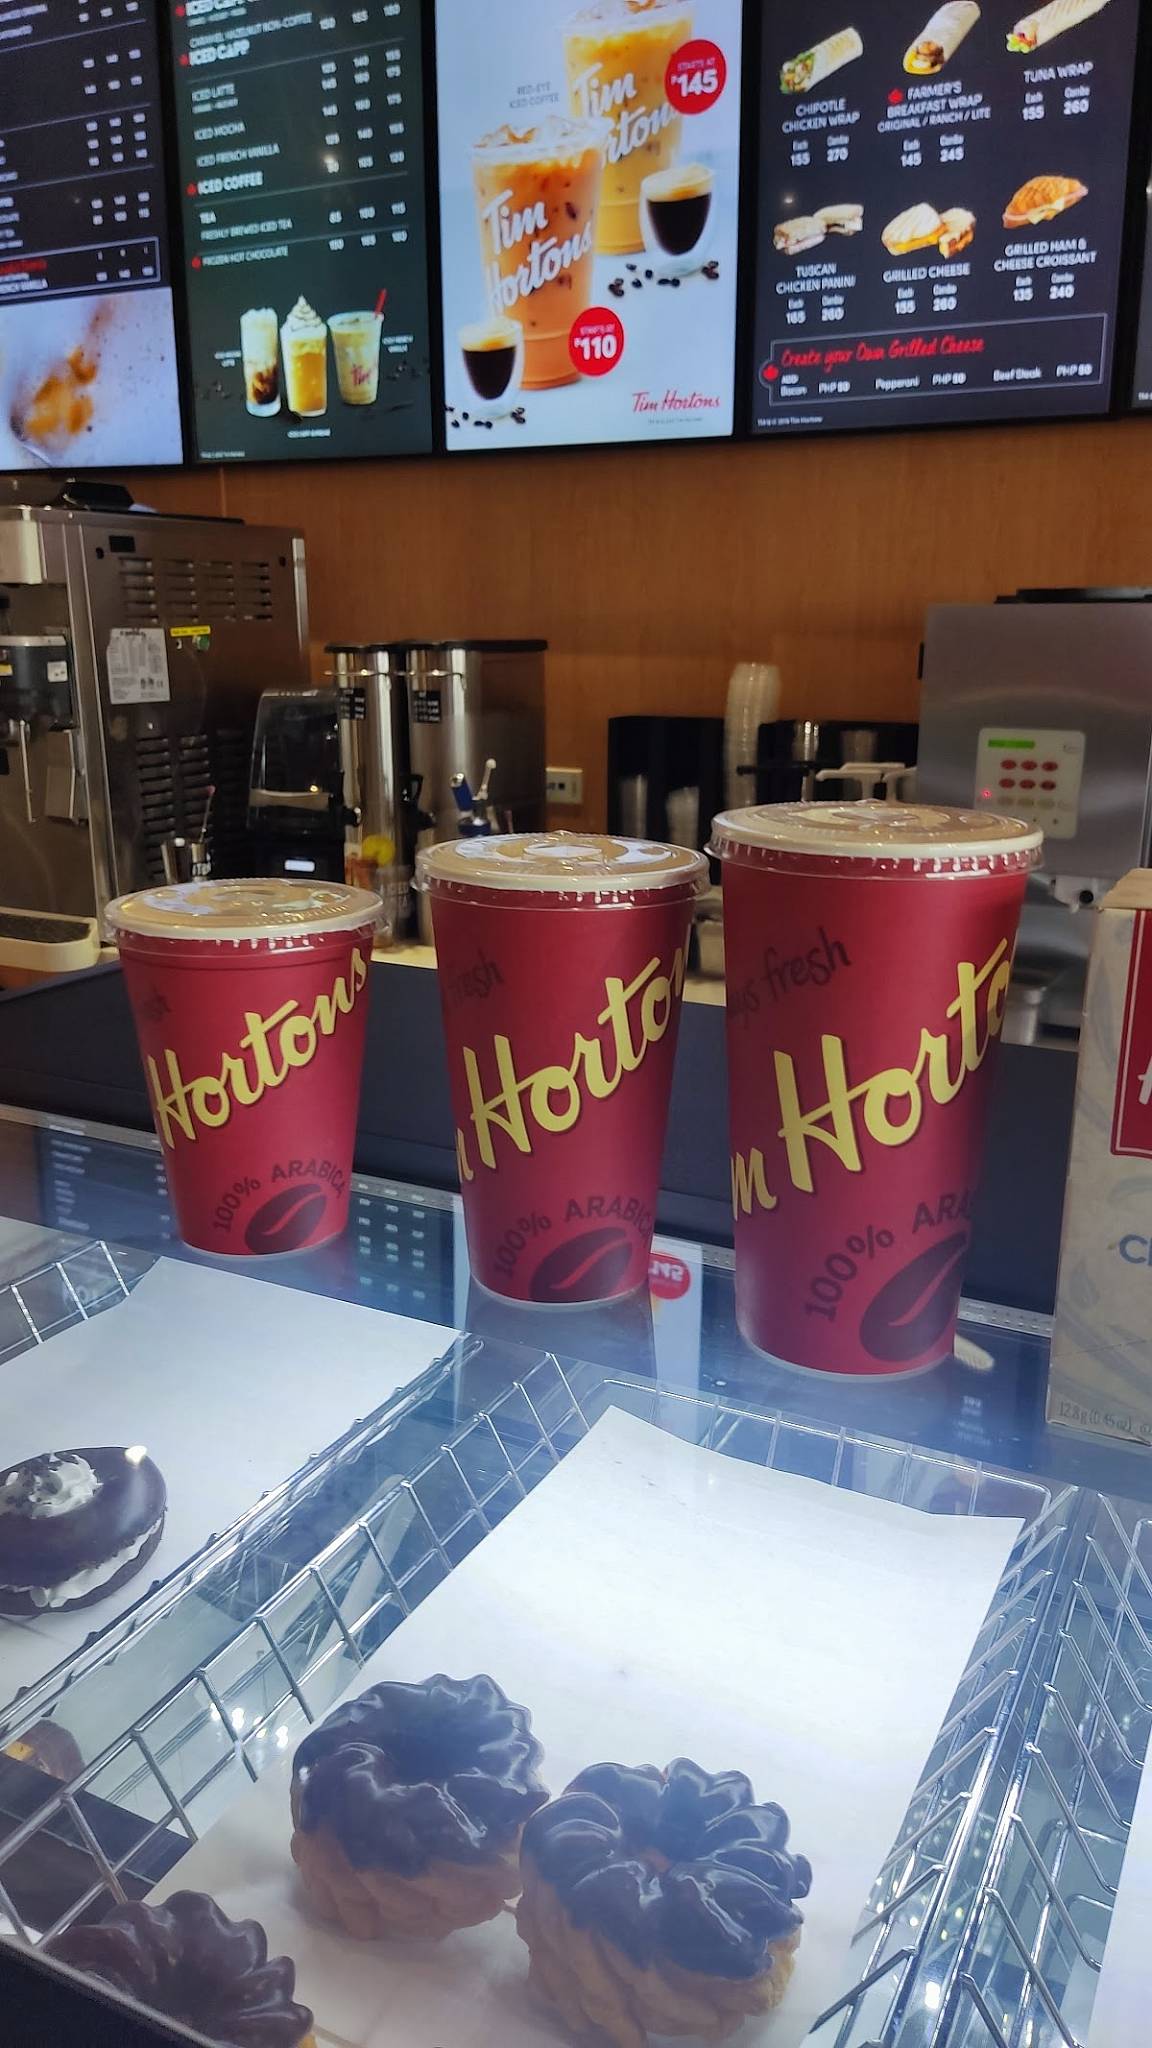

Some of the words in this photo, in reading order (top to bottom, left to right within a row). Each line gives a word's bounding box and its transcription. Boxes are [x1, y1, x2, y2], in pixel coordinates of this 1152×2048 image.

[1023, 67, 1056, 83] TUNA
[1056, 61, 1094, 79] WRAP
[573, 62, 637, 120] Tim
[795, 97, 846, 117] CHIPOTLE
[887, 98, 947, 119] BREAKFAST
[948, 93, 983, 109] WRAP
[782, 117, 827, 133] CHICKEN
[828, 111, 860, 127] WRAP
[877, 117, 921, 133] ORIGINAL
[971, 106, 991, 120] LITE
[481, 189, 549, 257] Tim
[1004, 241, 1050, 257] GRILLED
[1050, 238, 1078, 253] HAM
[795, 262, 837, 278] TUSCAN
[883, 266, 928, 283] GRILLED
[928, 262, 970, 279] CHEESE
[993, 256, 1035, 272] CHEESE
[1036, 250, 1097, 268] CROISSANT
[775, 278, 821, 295] CHICKEN
[821, 274, 857, 290] PANINI
[780, 350, 821, 368] Create
[823, 350, 853, 374] your
[856, 341, 885, 361] Own
[888, 337, 938, 359] Grilled
[939, 334, 985, 355] Cheese
[632, 391, 658, 413] Tim
[660, 388, 721, 412] Hortons
[763, 925, 852, 1003] fresh
[147, 946, 368, 1150] Hortons
[212, 1176, 262, 1233] 100%
[271, 1159, 347, 1199] ARABICA
[494, 1210, 553, 1279] 100%
[804, 1224, 895, 1323] 100%
